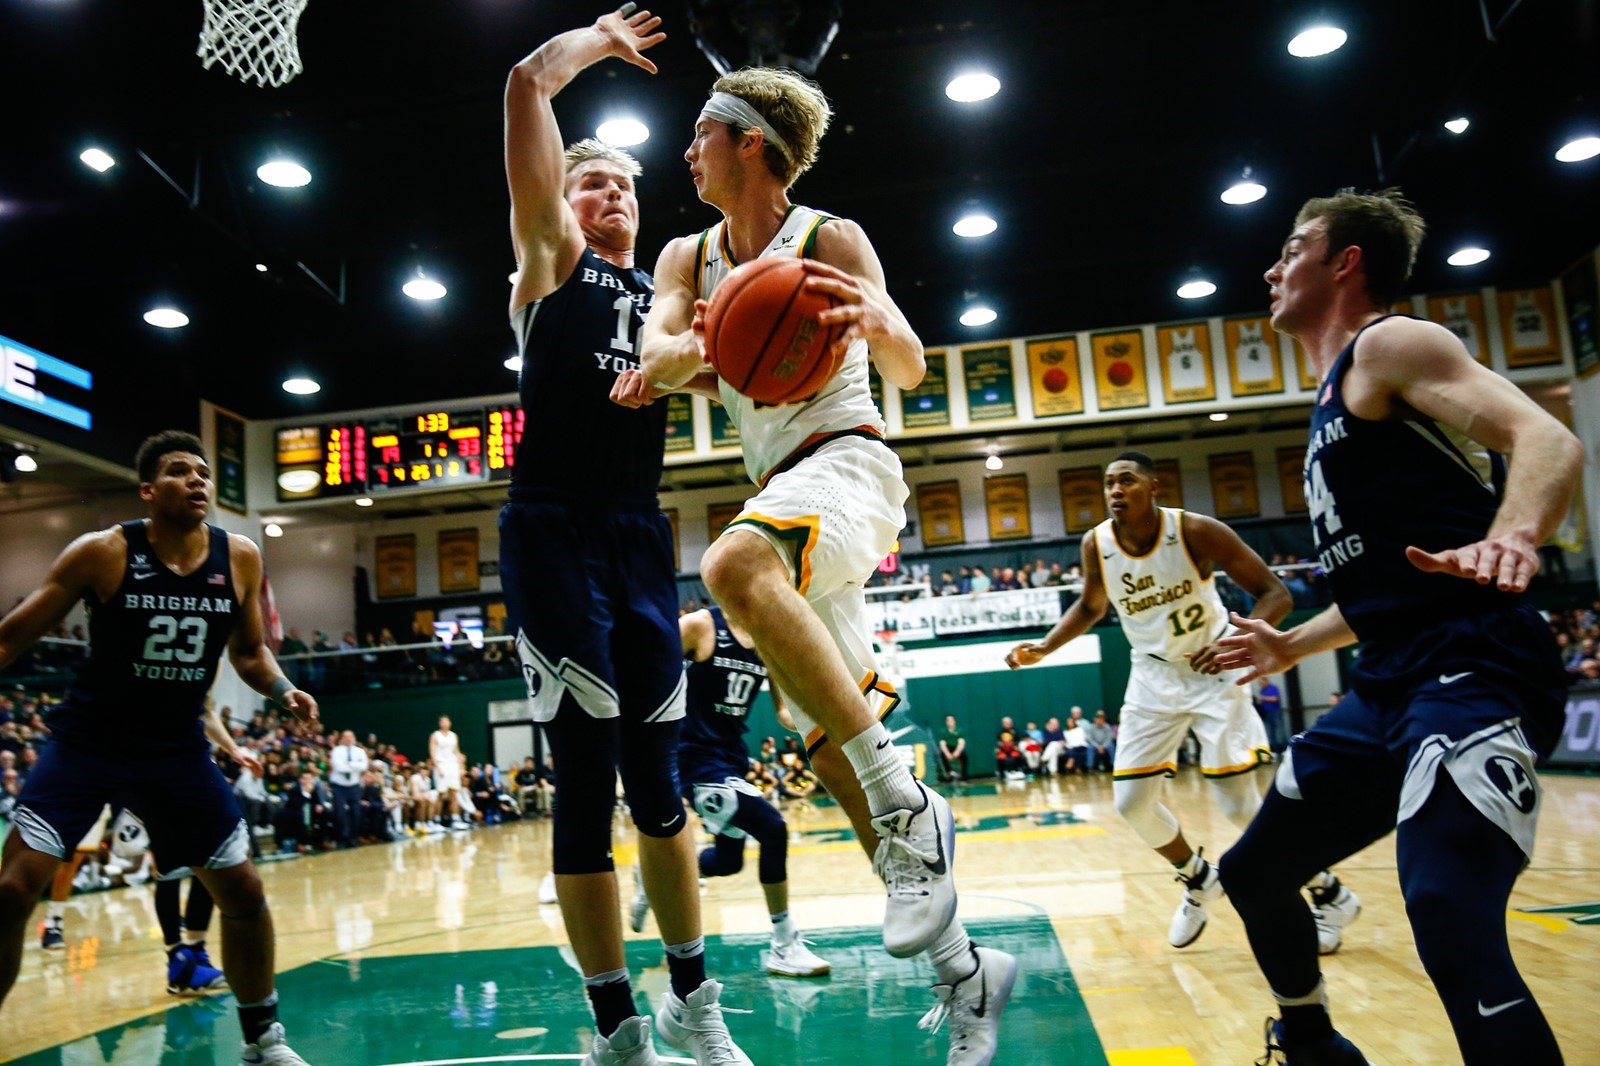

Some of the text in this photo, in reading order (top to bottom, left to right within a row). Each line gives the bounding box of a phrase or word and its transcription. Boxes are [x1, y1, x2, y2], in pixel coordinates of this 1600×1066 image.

[0, 344, 45, 404] E.
[417, 412, 449, 433] 1:33
[1119, 579, 1193, 616] Francisco
[1121, 572, 1156, 595] San
[124, 593, 232, 613] BRIGHAM
[985, 607, 1047, 625] Today
[1167, 603, 1206, 637] 12
[142, 615, 208, 663] 23
[132, 662, 206, 681] YOUNG
[724, 671, 756, 705] 10
